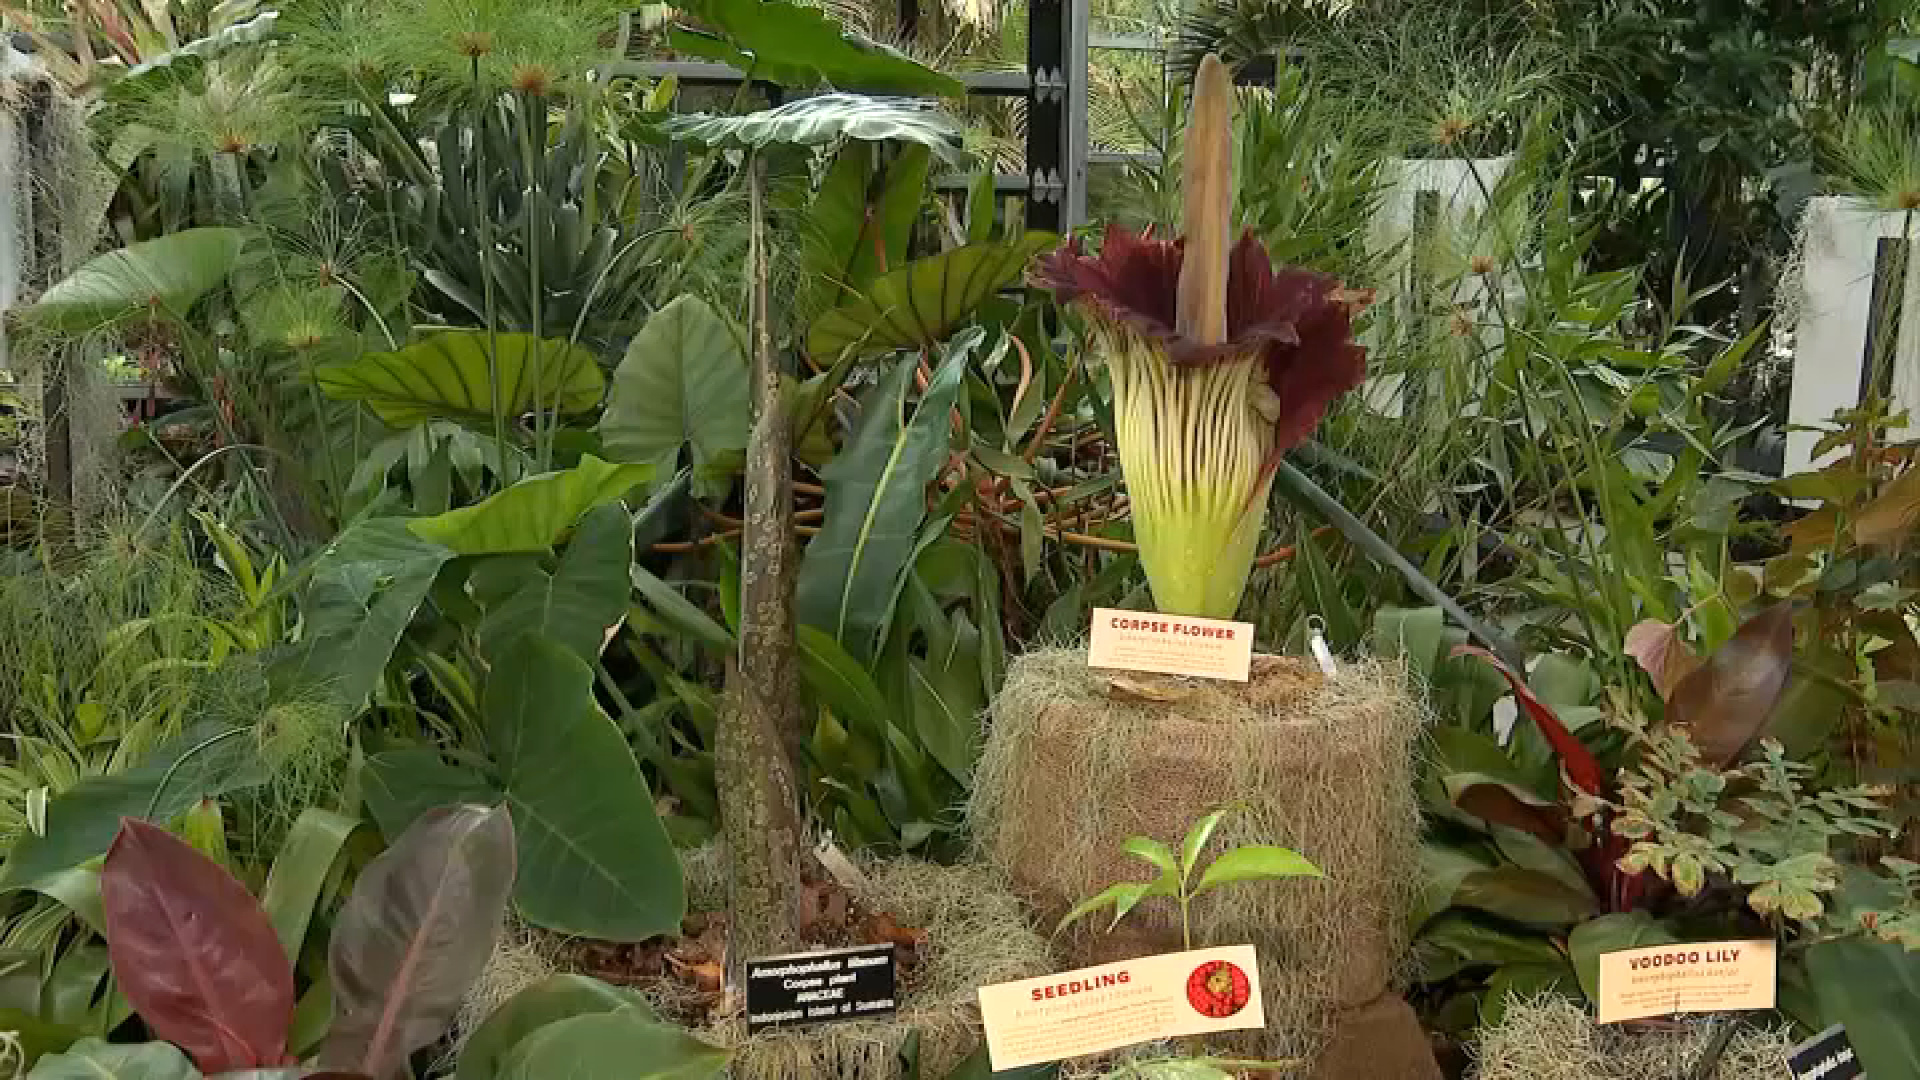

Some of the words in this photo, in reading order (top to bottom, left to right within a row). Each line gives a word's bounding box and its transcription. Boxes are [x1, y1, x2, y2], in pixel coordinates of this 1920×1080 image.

[1111, 618, 1168, 632] CORPSE
[1173, 624, 1234, 639] FLOWER
[1629, 952, 1699, 970] VOODOO
[1706, 949, 1741, 963] LILY
[1031, 971, 1130, 1000] SEEDLING
